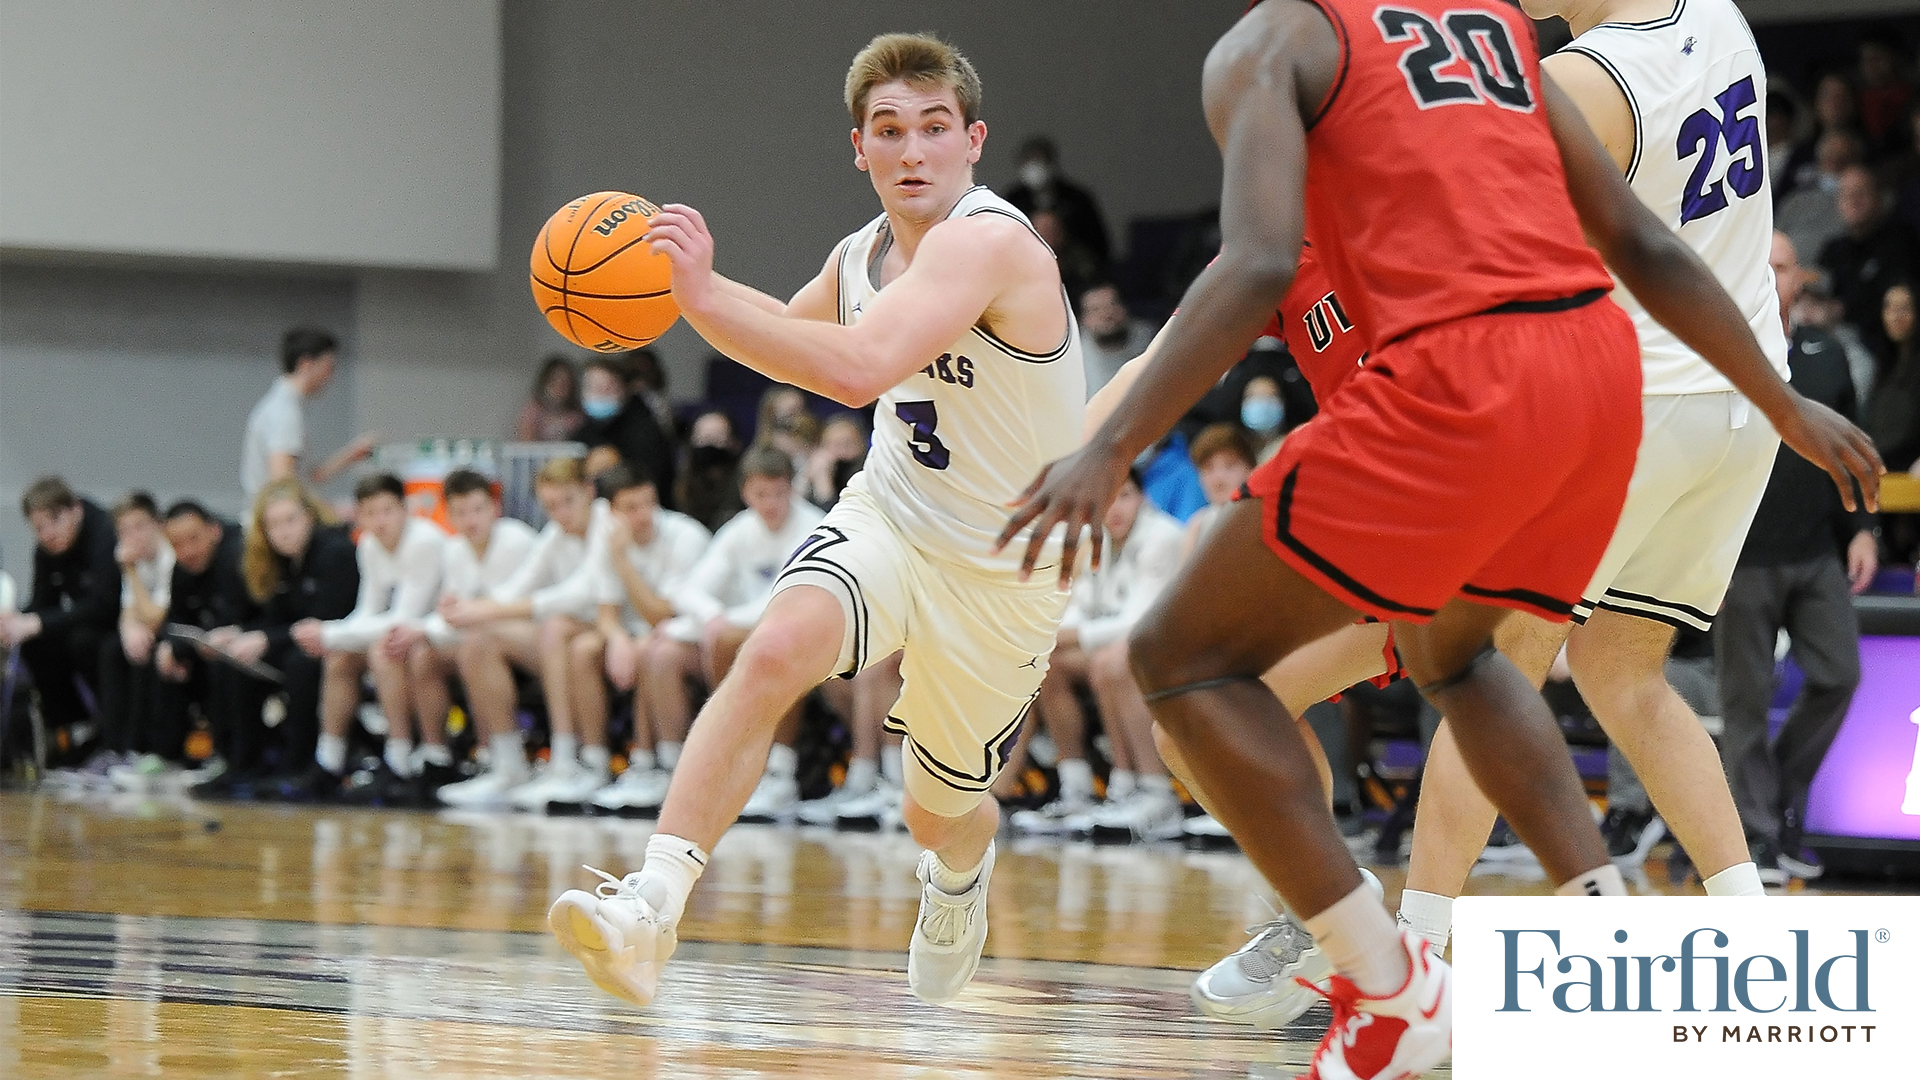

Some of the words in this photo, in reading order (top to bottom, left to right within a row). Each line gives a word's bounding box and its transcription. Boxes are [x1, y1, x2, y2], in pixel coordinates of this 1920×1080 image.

[1372, 5, 1537, 114] 20
[1676, 73, 1764, 228] 25
[592, 198, 664, 237] ilson
[917, 352, 975, 390] KS
[895, 400, 950, 471] 3
